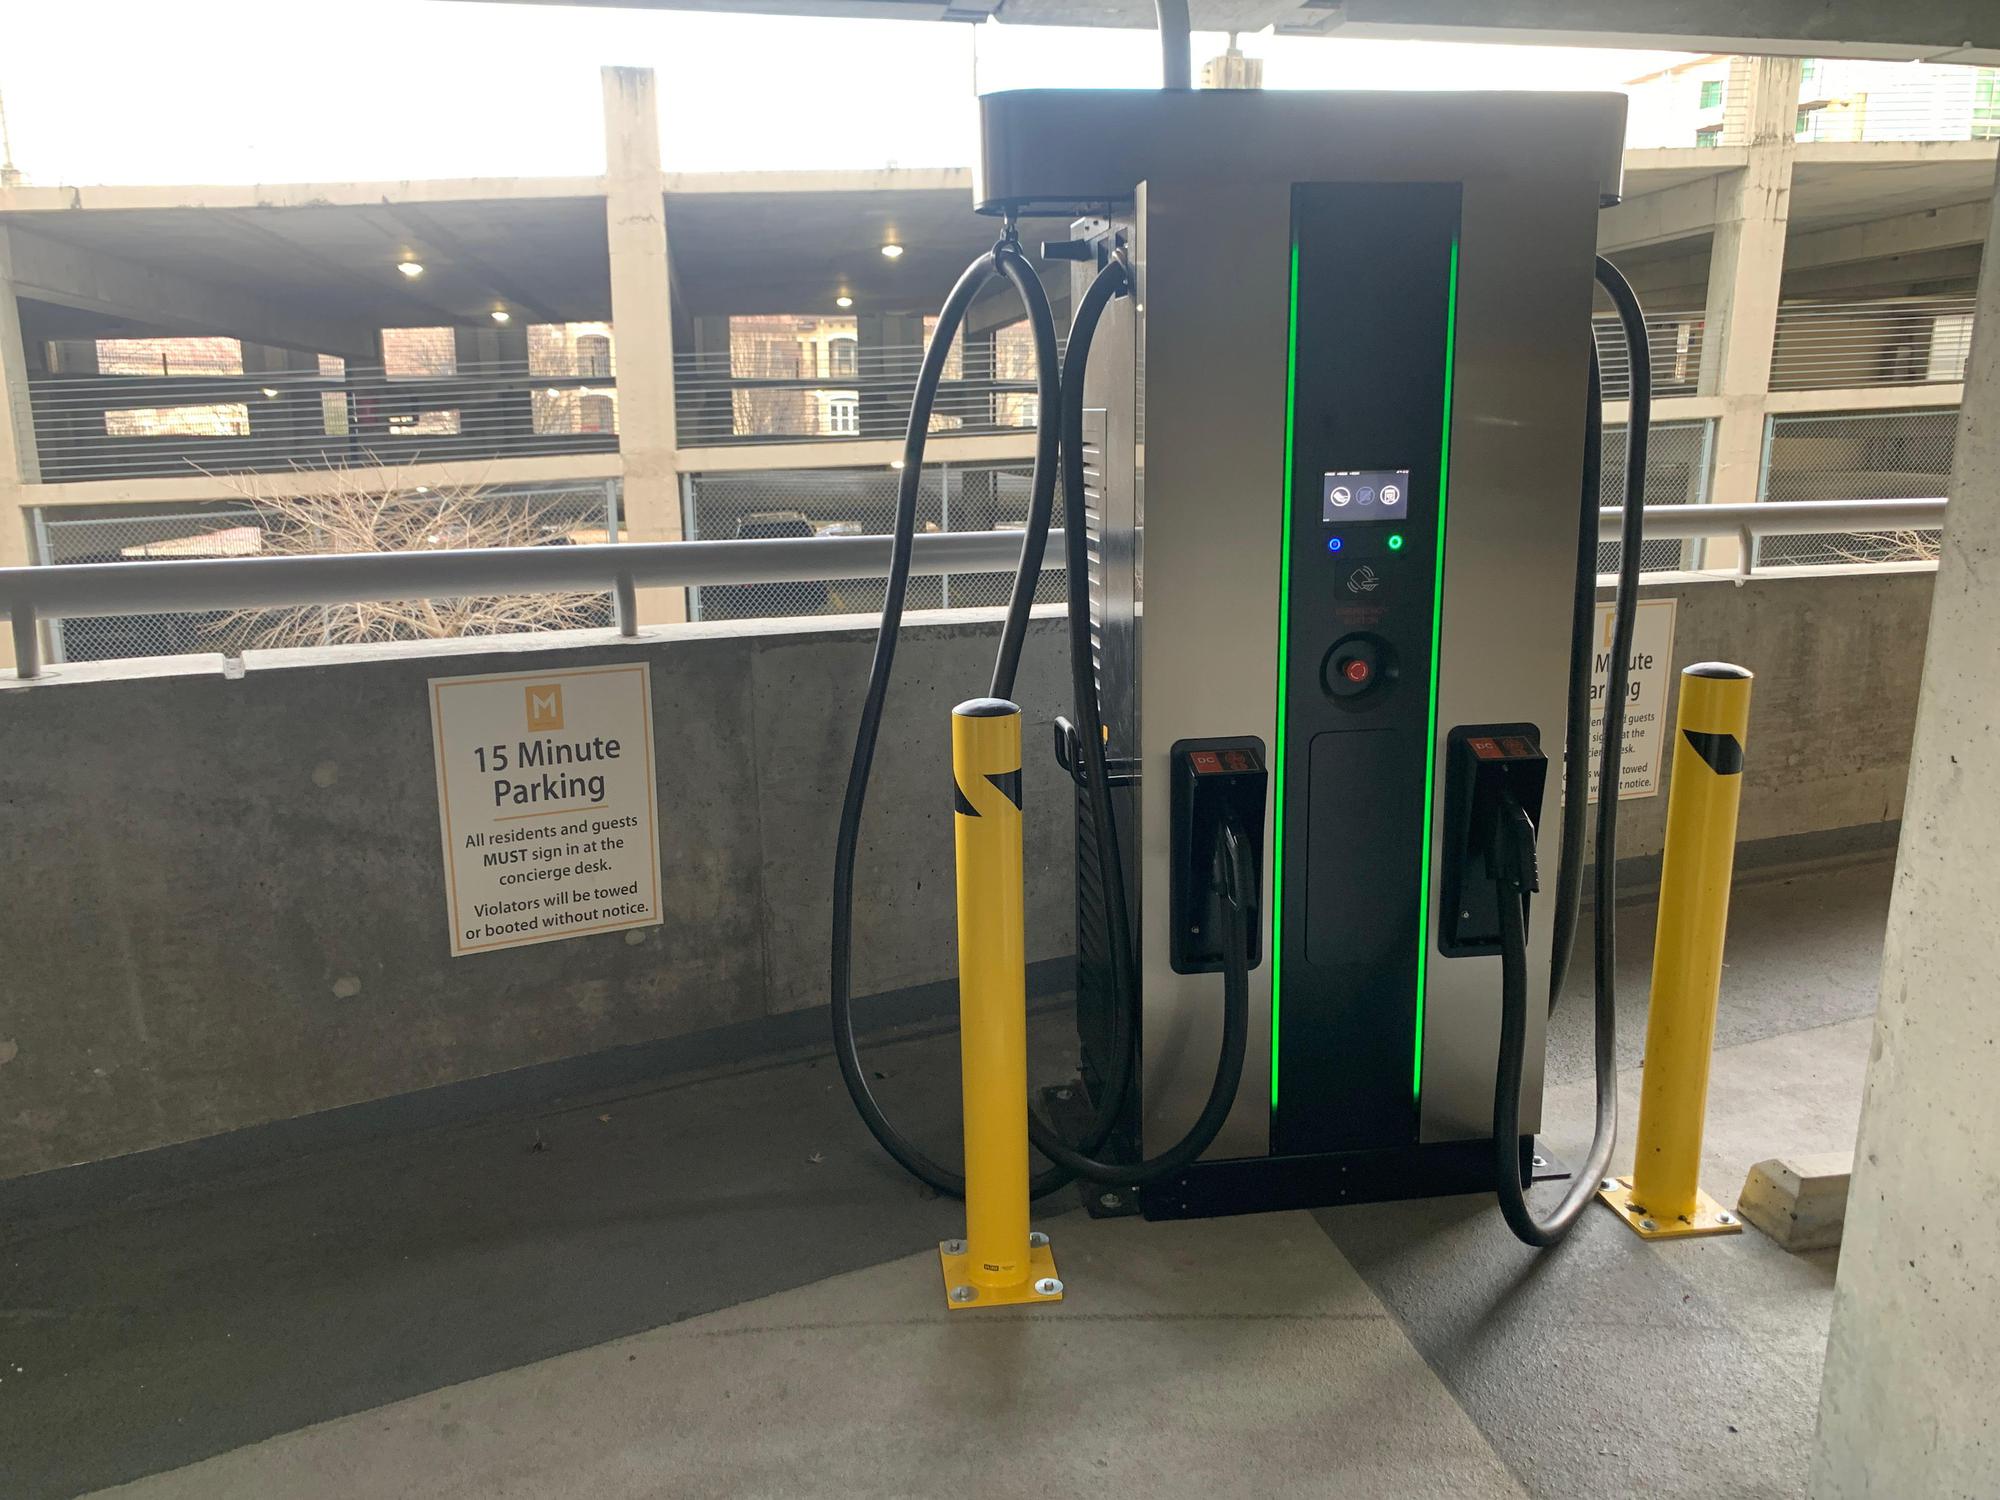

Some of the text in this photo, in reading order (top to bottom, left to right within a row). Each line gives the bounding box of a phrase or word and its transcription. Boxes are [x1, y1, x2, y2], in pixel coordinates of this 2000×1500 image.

[1595, 652, 1653, 673] Mute
[532, 691, 556, 719] M
[1628, 713, 1655, 725] guests
[1476, 742, 1493, 750] DC
[1632, 728, 1645, 738] the
[474, 736, 621, 773] 15 Minute
[1622, 763, 1648, 774] towed
[494, 773, 605, 807] Parking
[1624, 778, 1652, 790] notice.
[465, 815, 638, 849] All residents and guests
[483, 837, 624, 867] MUST sign in at the
[499, 859, 612, 886] concierge desk.
[474, 881, 638, 918] Violators will be towed
[465, 902, 649, 941] or booted without notice.
